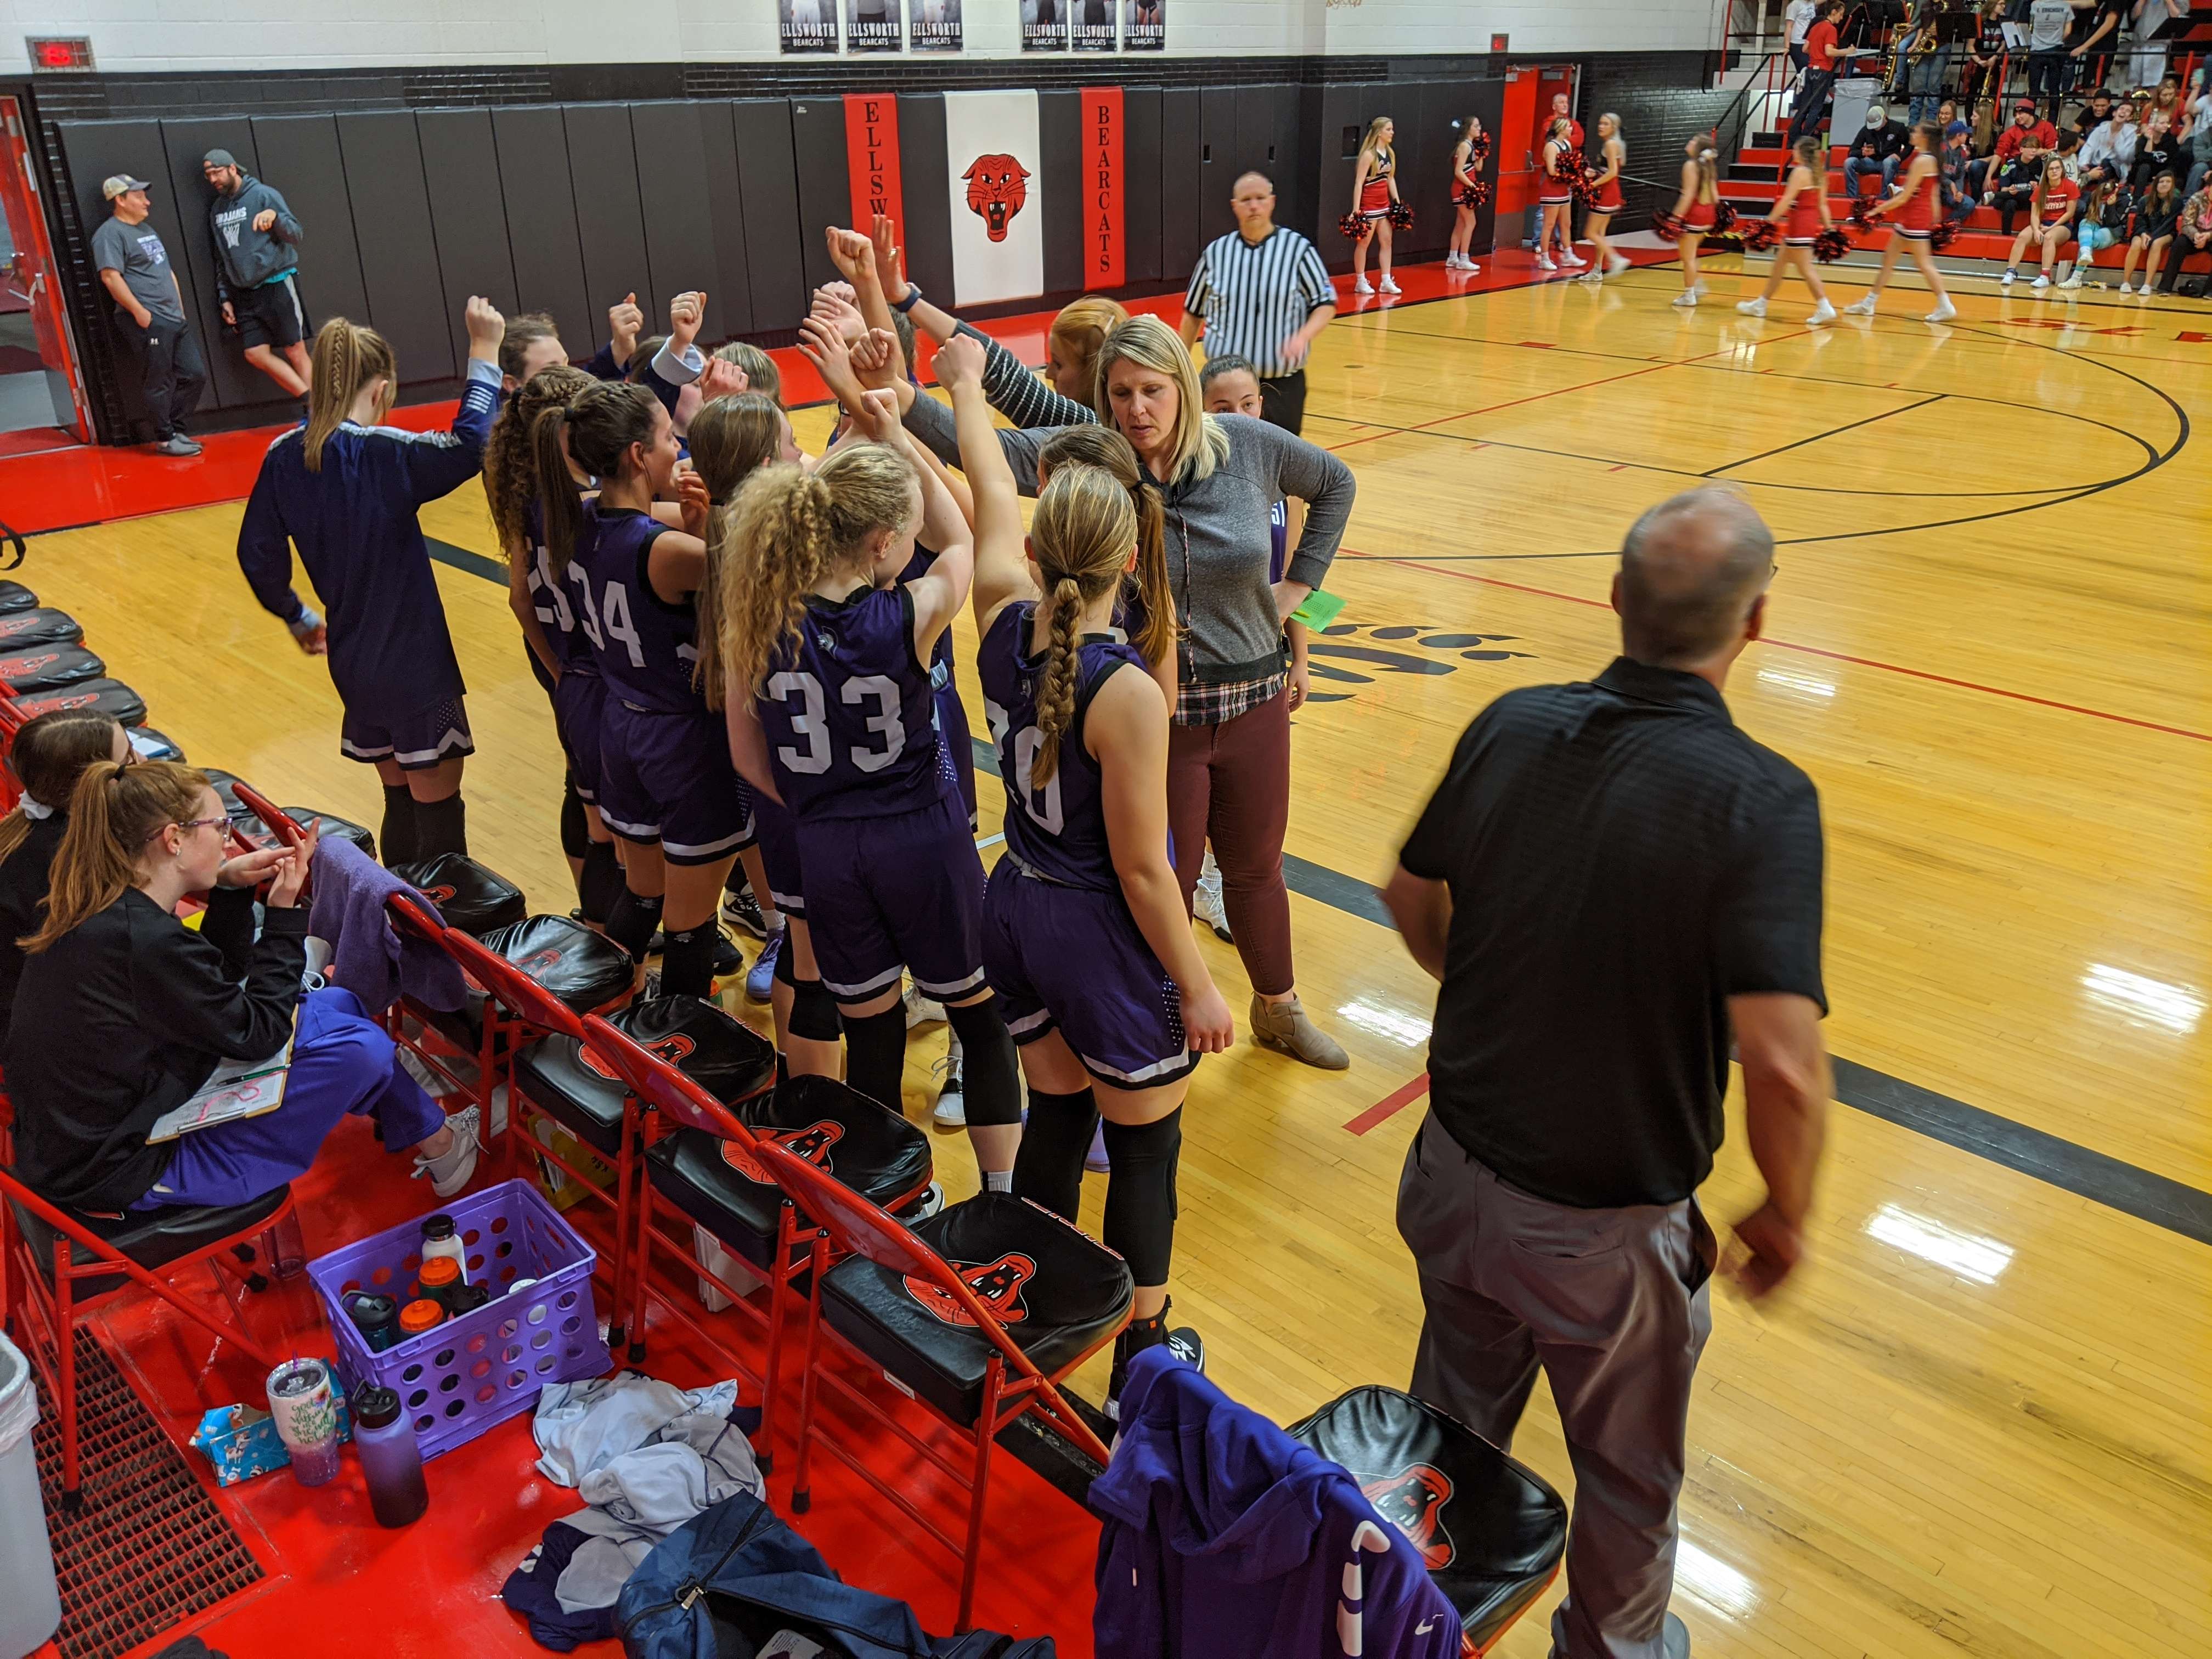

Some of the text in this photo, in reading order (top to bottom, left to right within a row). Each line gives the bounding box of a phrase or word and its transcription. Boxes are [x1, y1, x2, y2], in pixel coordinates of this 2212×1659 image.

[781, 23, 836, 37] ELLSWORTH
[848, 23, 899, 37] ELLSWORTH
[912, 22, 960, 36] ELLSWORTH
[1024, 24, 1066, 37] ELLSWORTH
[1073, 25, 1115, 37] ELLSWORTH
[1125, 25, 1163, 37] ELLSWORTH
[793, 38, 824, 47] BEARCATS
[859, 38, 889, 46] BEARCATS
[922, 37, 951, 45] BEARCATS
[1098, 106, 1111, 272] BEARCATS
[216, 207, 246, 224] TROJANS
[567, 558, 647, 668] 34
[767, 672, 906, 775] 33
